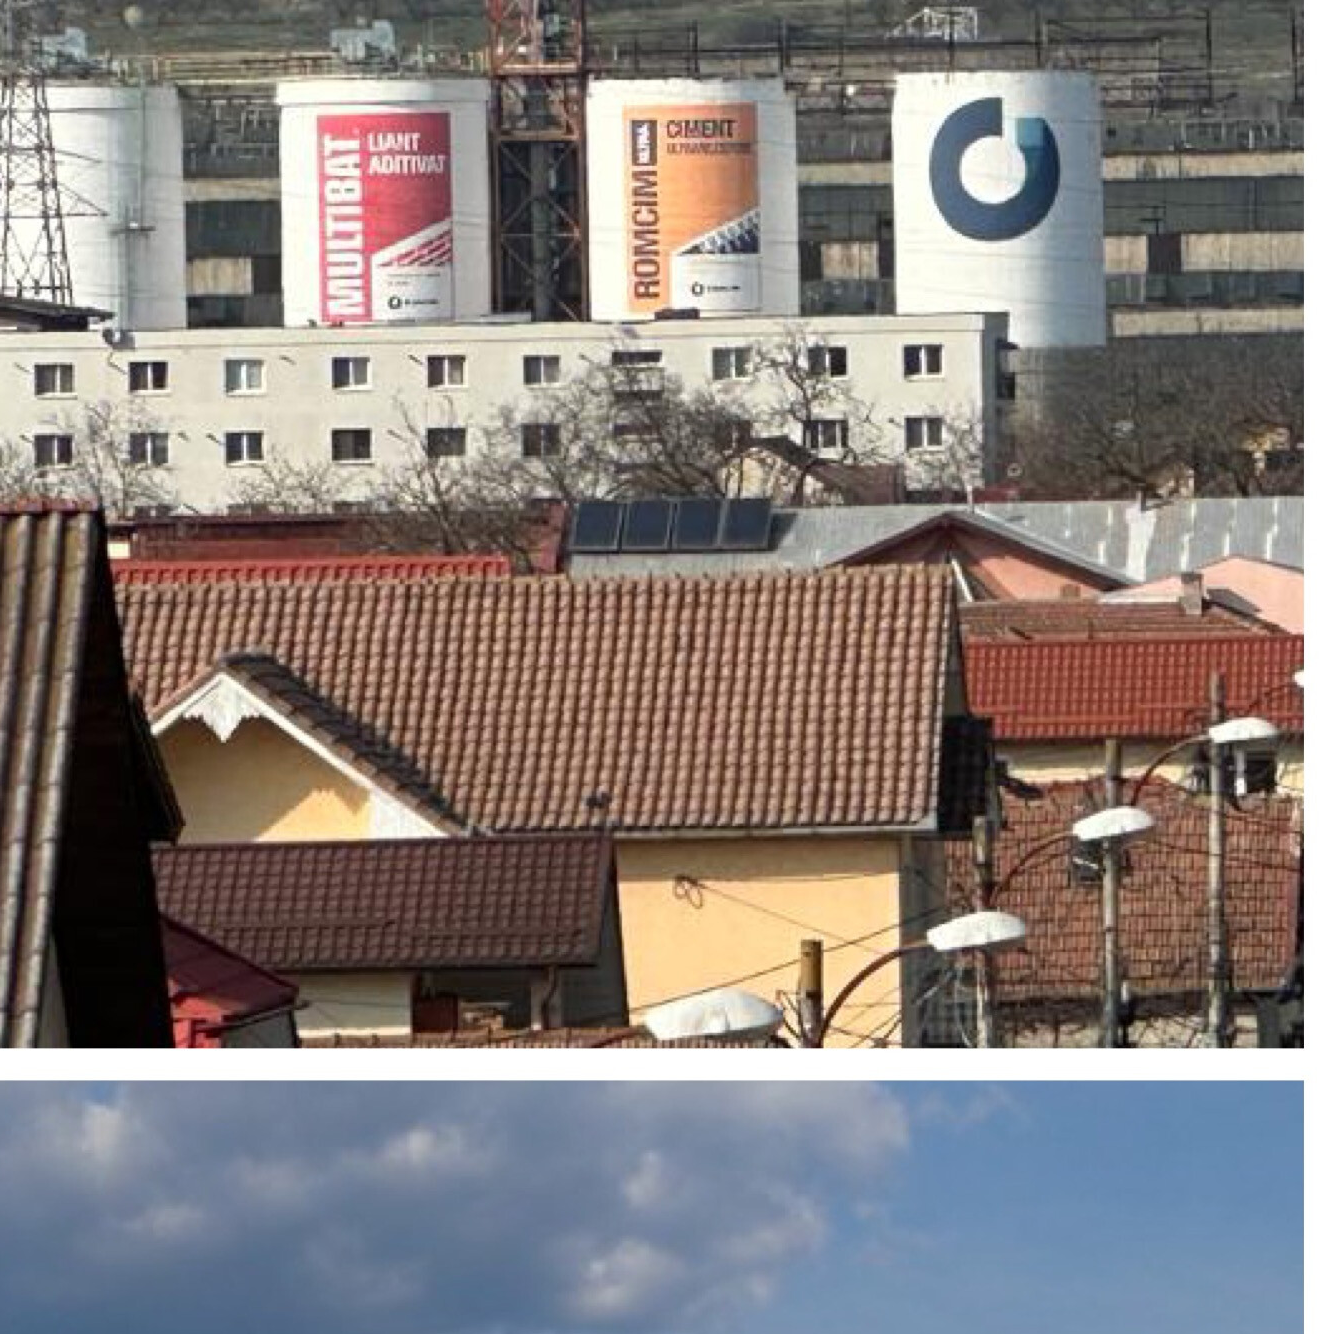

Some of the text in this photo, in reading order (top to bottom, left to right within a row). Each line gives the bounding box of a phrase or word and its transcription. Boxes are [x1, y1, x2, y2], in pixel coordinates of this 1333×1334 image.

[666, 119, 737, 139] CIMENT
[367, 131, 421, 152] LIANT
[369, 155, 447, 177] ADITIVAT
[324, 133, 366, 316] MULTIBAT
[631, 169, 661, 300] ROMCIM
